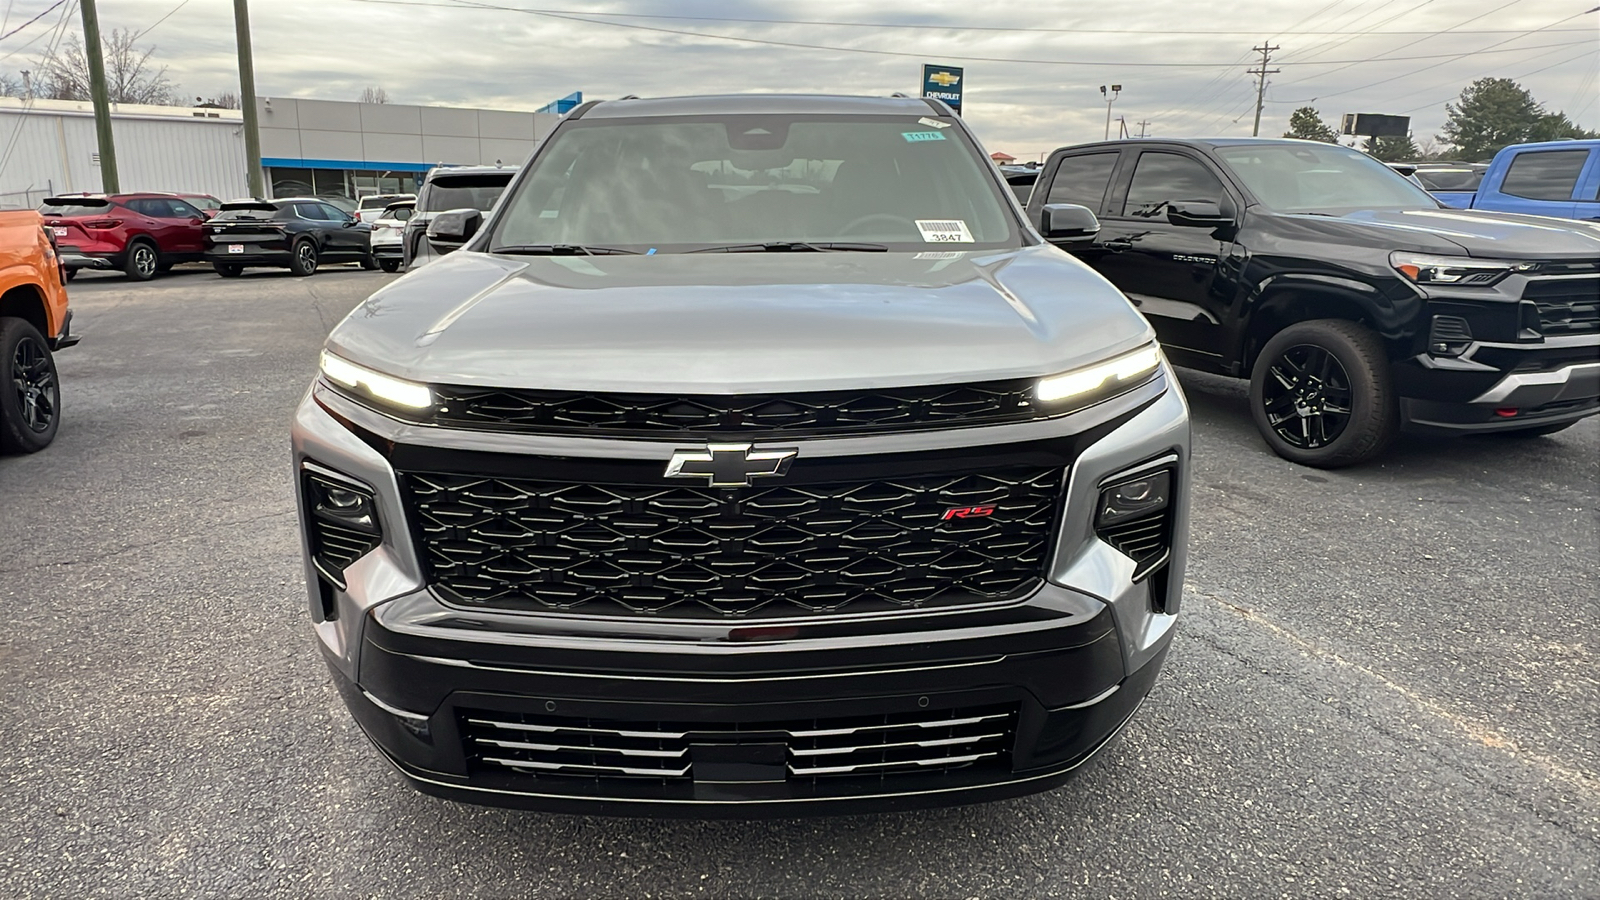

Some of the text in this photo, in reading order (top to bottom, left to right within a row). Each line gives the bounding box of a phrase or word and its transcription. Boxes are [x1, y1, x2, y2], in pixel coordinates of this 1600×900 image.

[926, 91, 960, 100] CHEVROLET
[932, 233, 961, 241] 3847
[1173, 254, 1217, 264] COLORADO
[940, 503, 997, 520] RS
